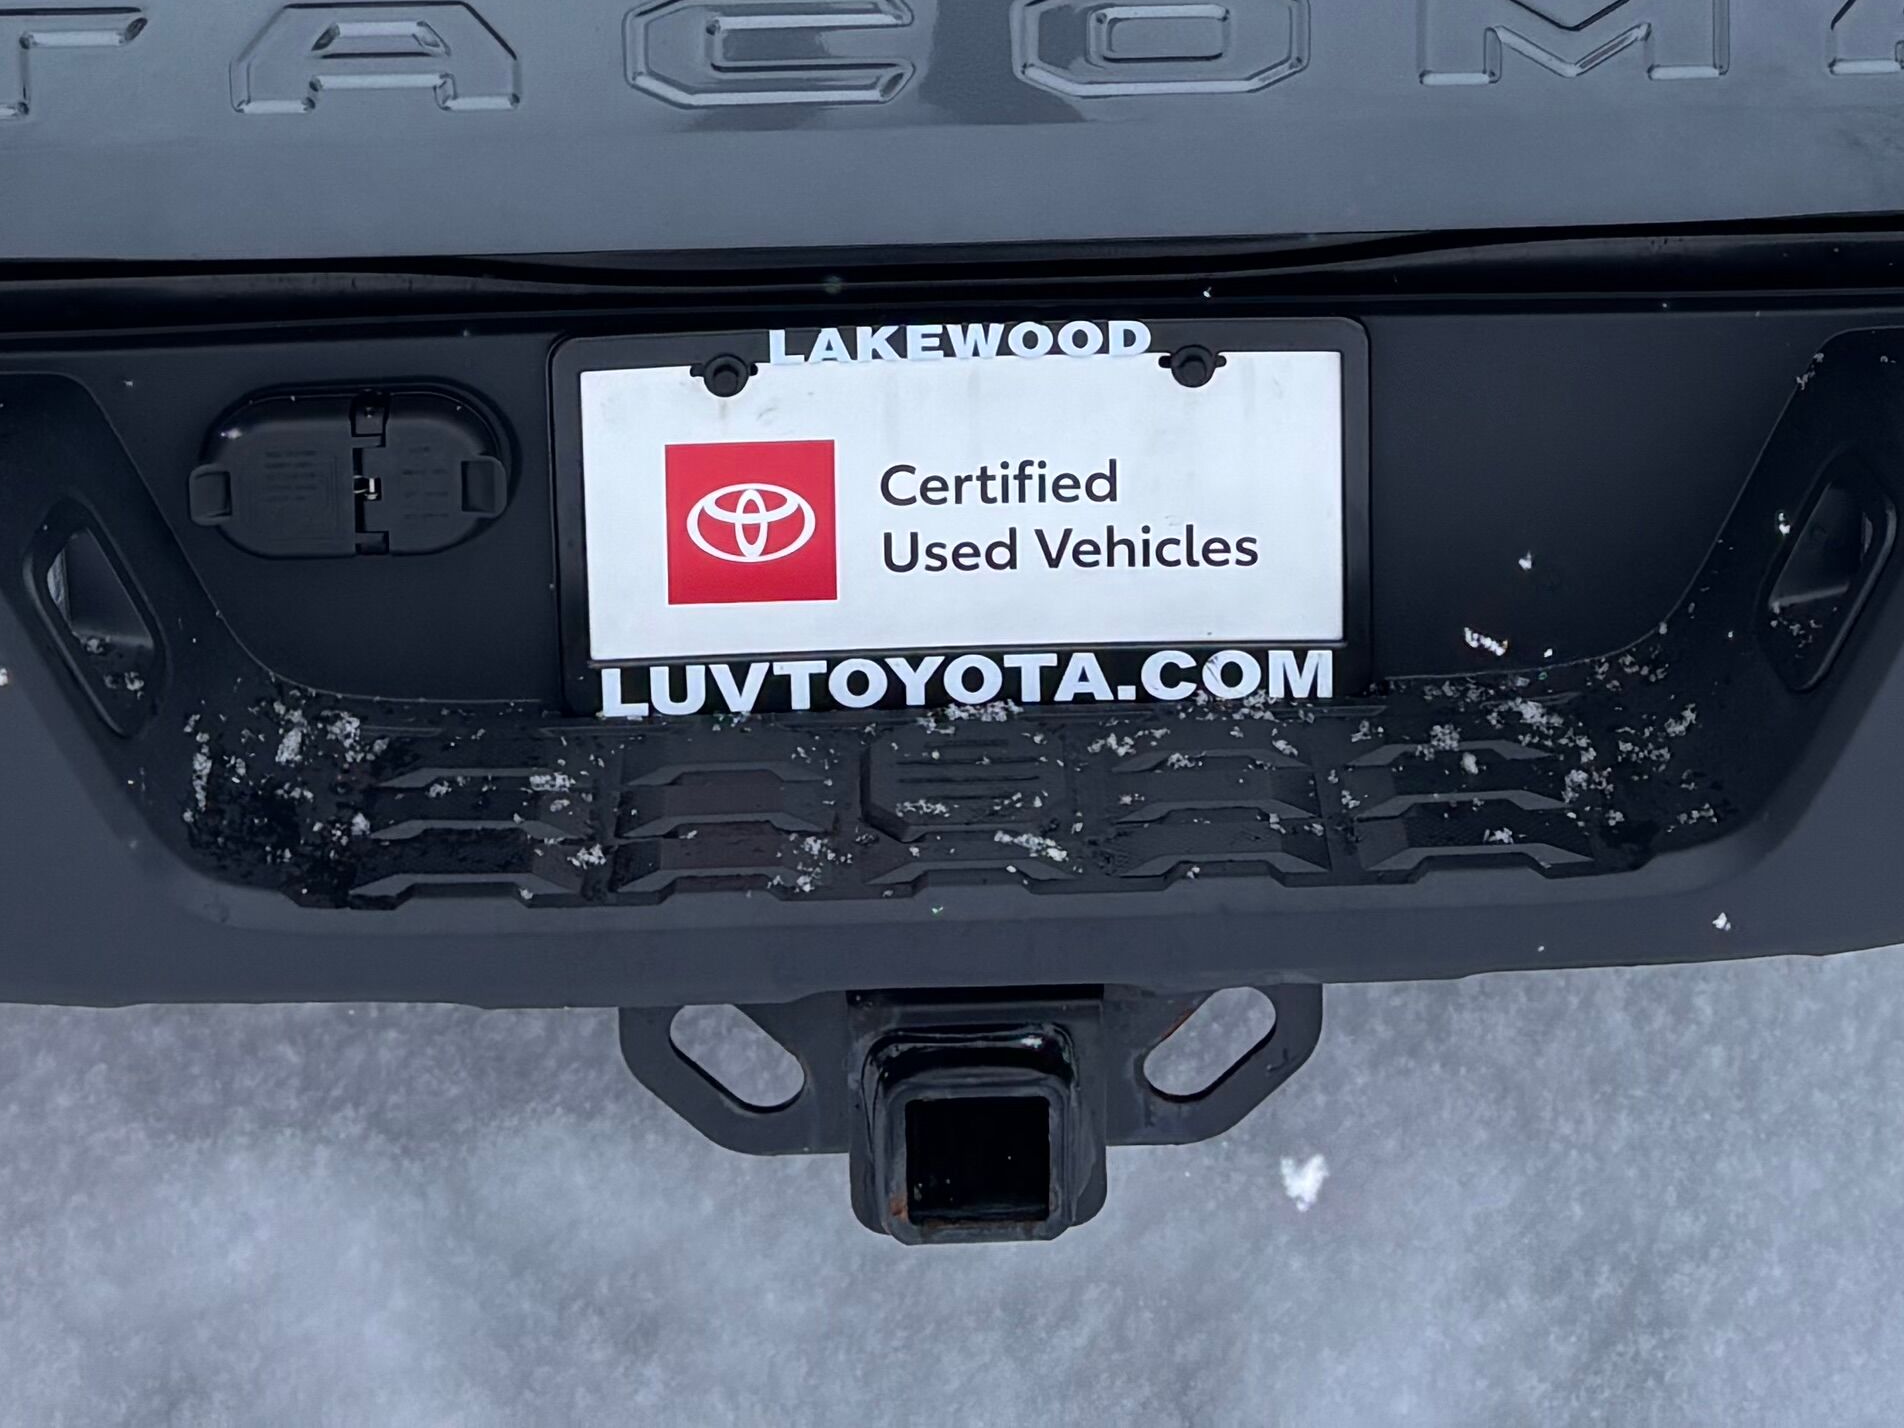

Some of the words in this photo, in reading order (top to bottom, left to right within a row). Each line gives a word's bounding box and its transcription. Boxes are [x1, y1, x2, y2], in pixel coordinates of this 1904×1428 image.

[768, 319, 1153, 367] LAKEWOOD
[880, 458, 1119, 507] Certified
[882, 526, 1018, 574] Used
[1034, 522, 1260, 571] Vehicles
[601, 648, 1334, 719] LUVTOYOTA.COM
